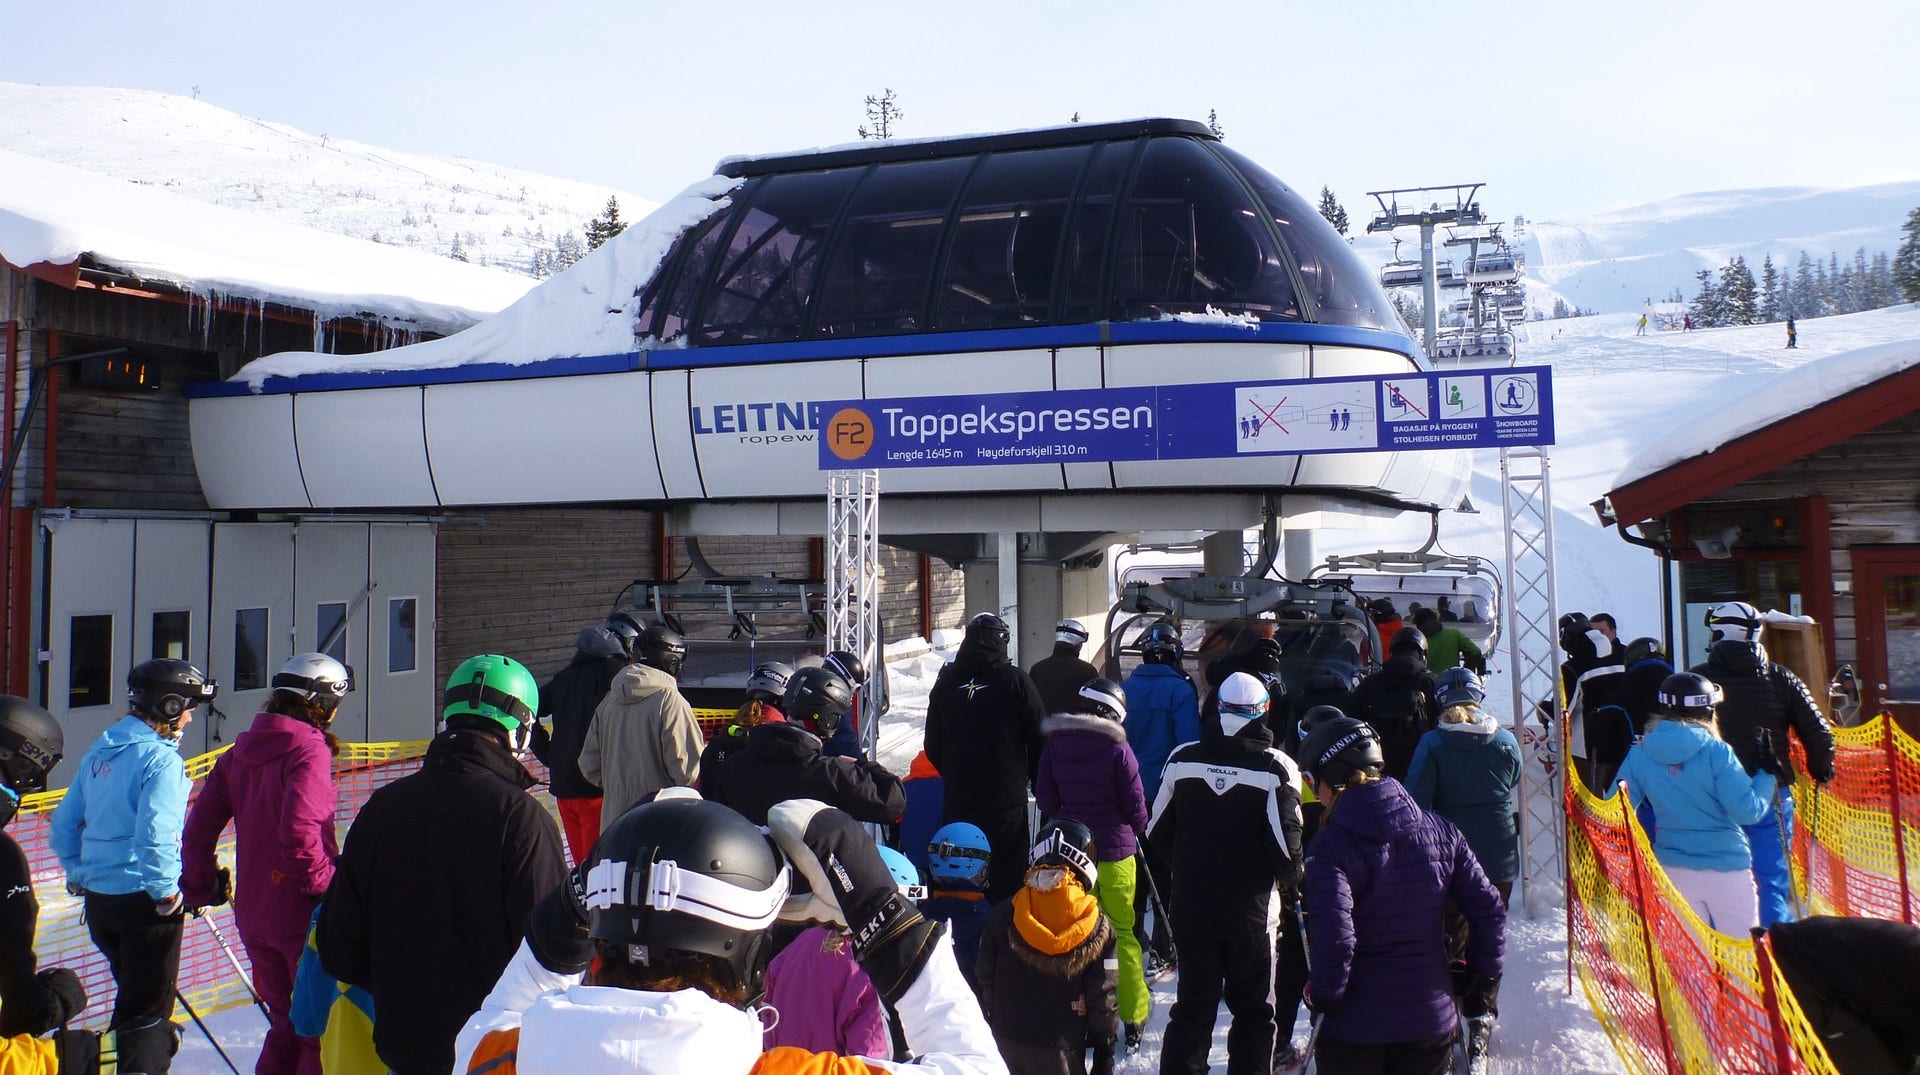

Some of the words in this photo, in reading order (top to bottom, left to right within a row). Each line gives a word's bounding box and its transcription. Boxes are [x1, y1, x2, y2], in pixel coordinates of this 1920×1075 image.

[693, 401, 819, 435] LEITNE
[882, 404, 1152, 443] Toppekspressen
[836, 421, 865, 445] F2
[1393, 424, 1429, 433] BAGASJE
[1430, 422, 1440, 431] PÅ
[1441, 422, 1474, 431] RYGGEN
[740, 434, 816, 445] ropew
[1393, 435, 1440, 444] STOLHEISEN
[1441, 433, 1478, 442] FORBUDT
[887, 449, 923, 461] Lengde
[925, 448, 952, 459] 1645
[953, 450, 963, 458] m
[977, 444, 1052, 459] Høydeforskjell
[1054, 444, 1075, 456] 310
[1077, 445, 1088, 455] m
[1207, 767, 1238, 776] nebulus
[1060, 842, 1090, 871] BLIZ
[854, 911, 886, 949] LEKI
